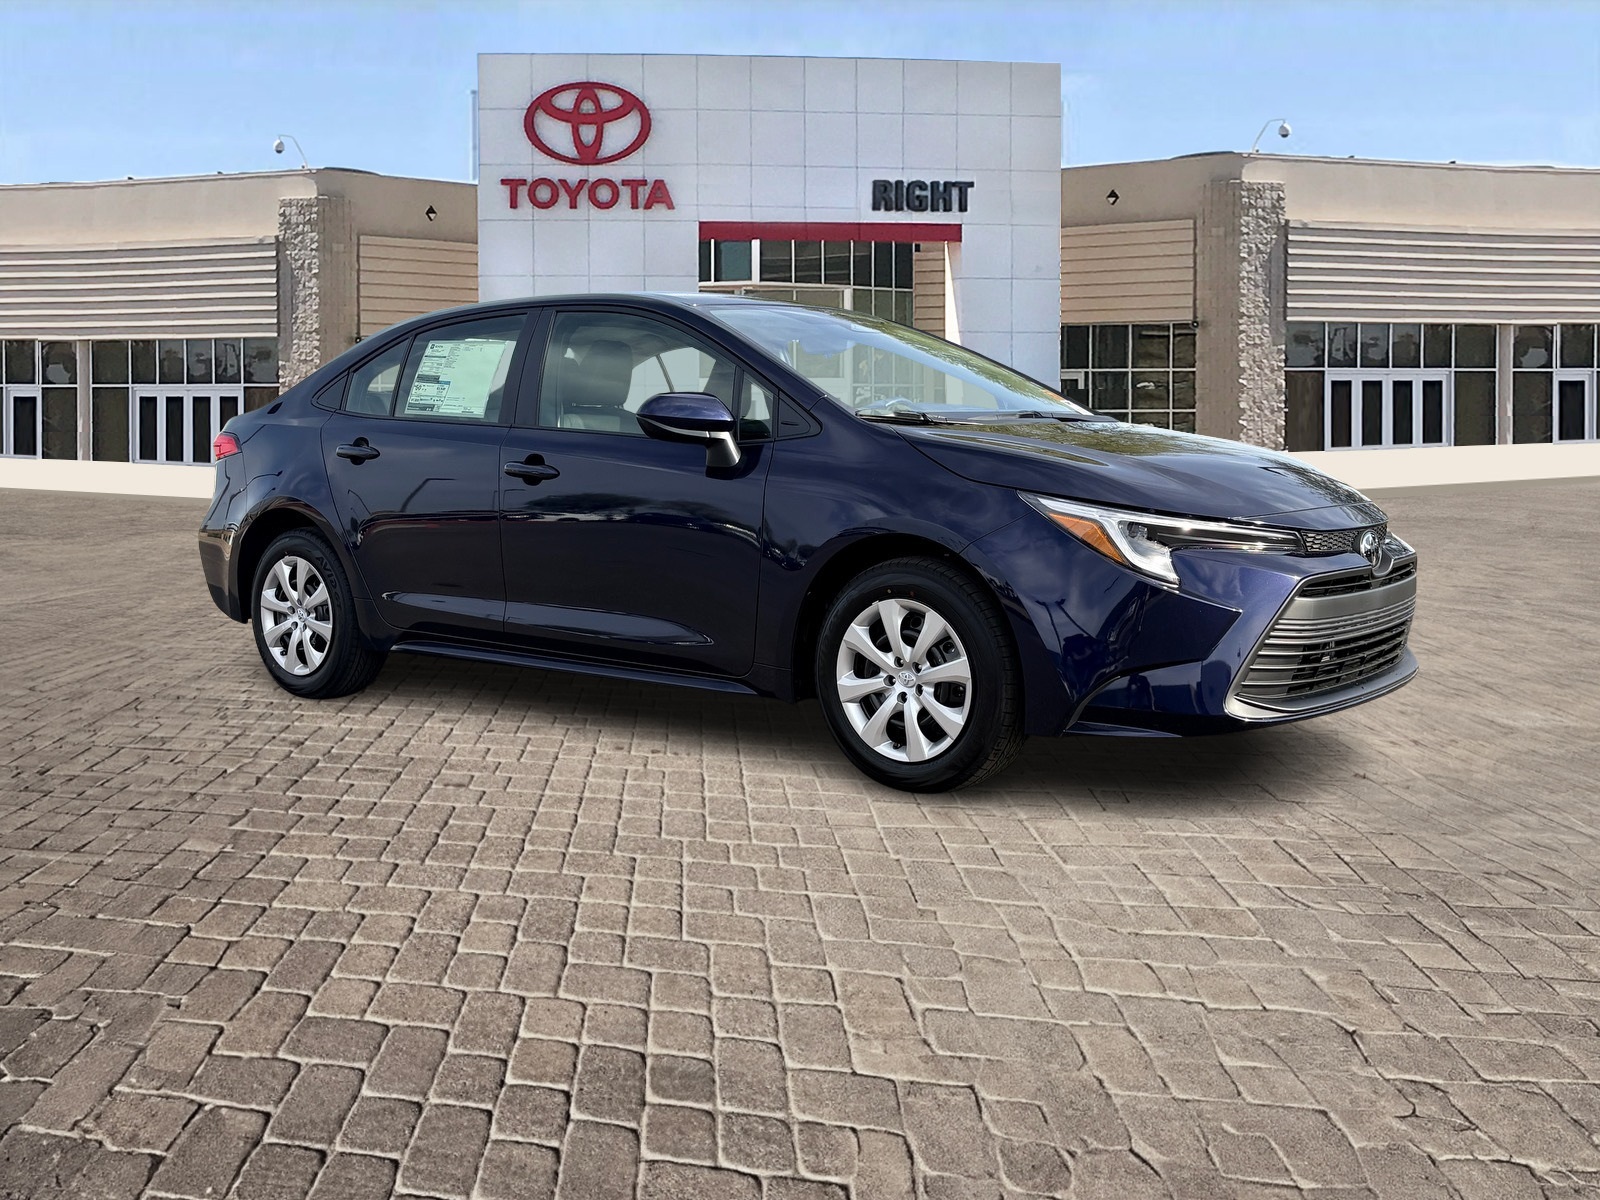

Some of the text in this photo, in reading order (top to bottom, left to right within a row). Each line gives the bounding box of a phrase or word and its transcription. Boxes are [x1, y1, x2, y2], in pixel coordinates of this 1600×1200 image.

[500, 178, 675, 210] TOYOTA
[871, 179, 975, 213] RIGHT
[315, 557, 336, 589] AVID
